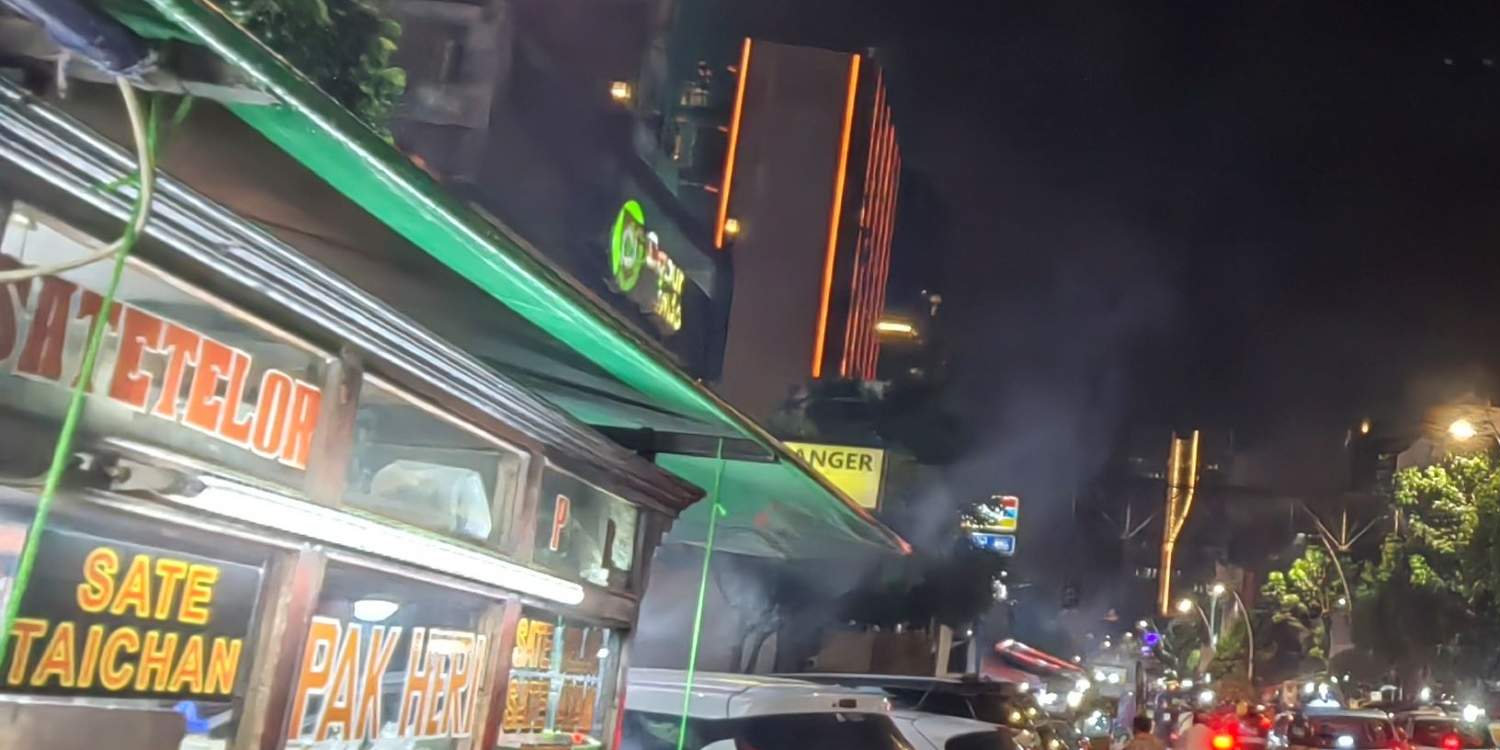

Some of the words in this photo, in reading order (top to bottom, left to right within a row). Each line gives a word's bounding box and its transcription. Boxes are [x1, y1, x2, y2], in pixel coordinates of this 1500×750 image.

[77, 546, 221, 625] SATE
[8, 617, 243, 695] TAICHAN
[286, 616, 403, 743] PAK
